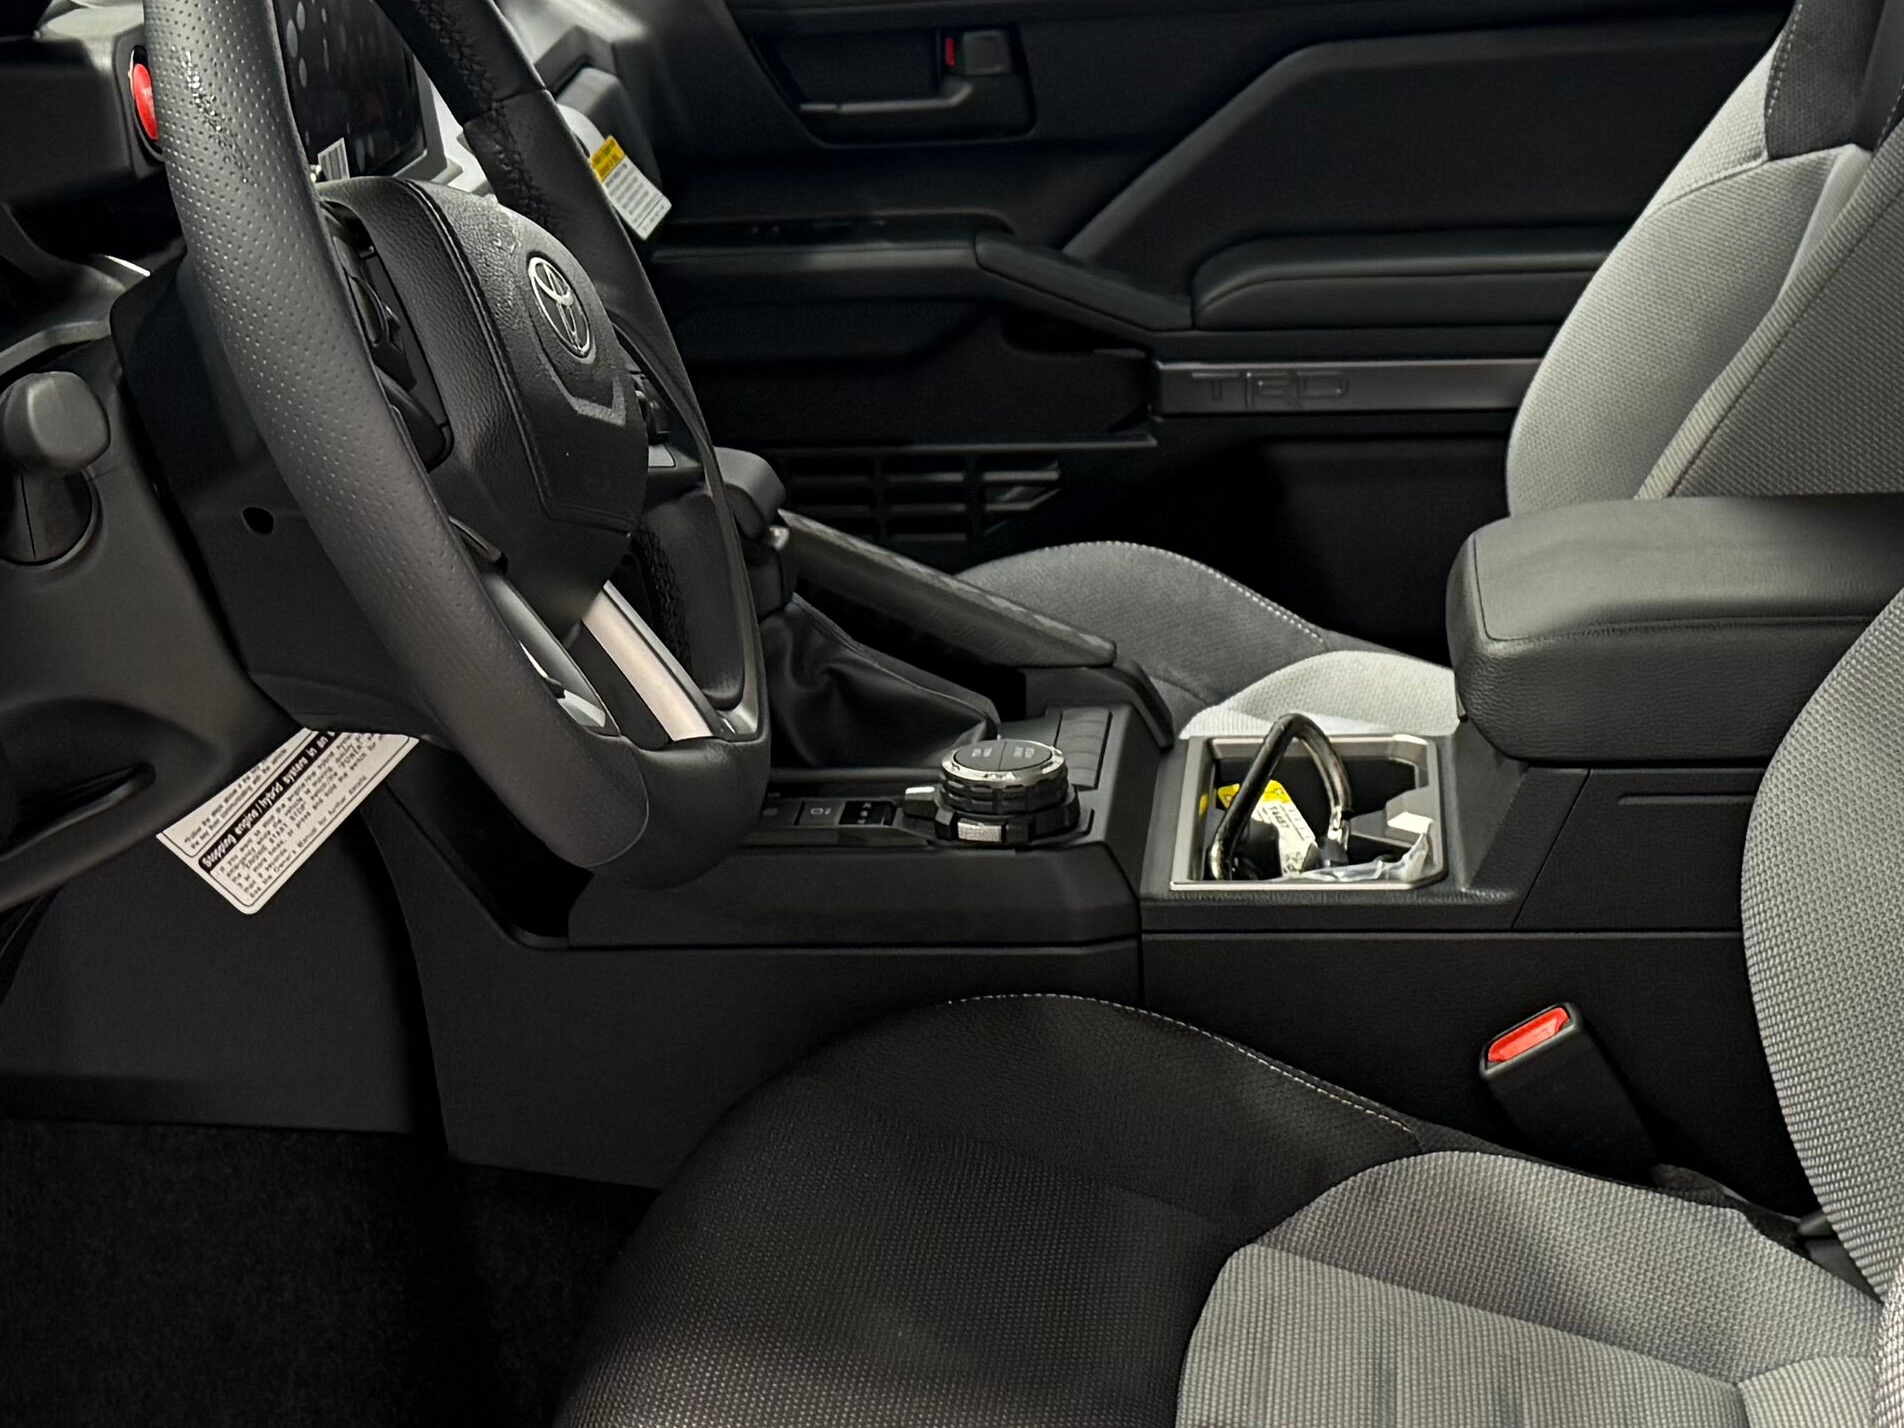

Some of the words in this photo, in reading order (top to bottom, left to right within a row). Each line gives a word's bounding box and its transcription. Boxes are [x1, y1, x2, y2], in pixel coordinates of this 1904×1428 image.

[1191, 371, 1349, 410] TRD
[202, 834, 236, 867] Stopping
[282, 757, 309, 783] system
[306, 747, 317, 756] in
[316, 736, 328, 747] an
